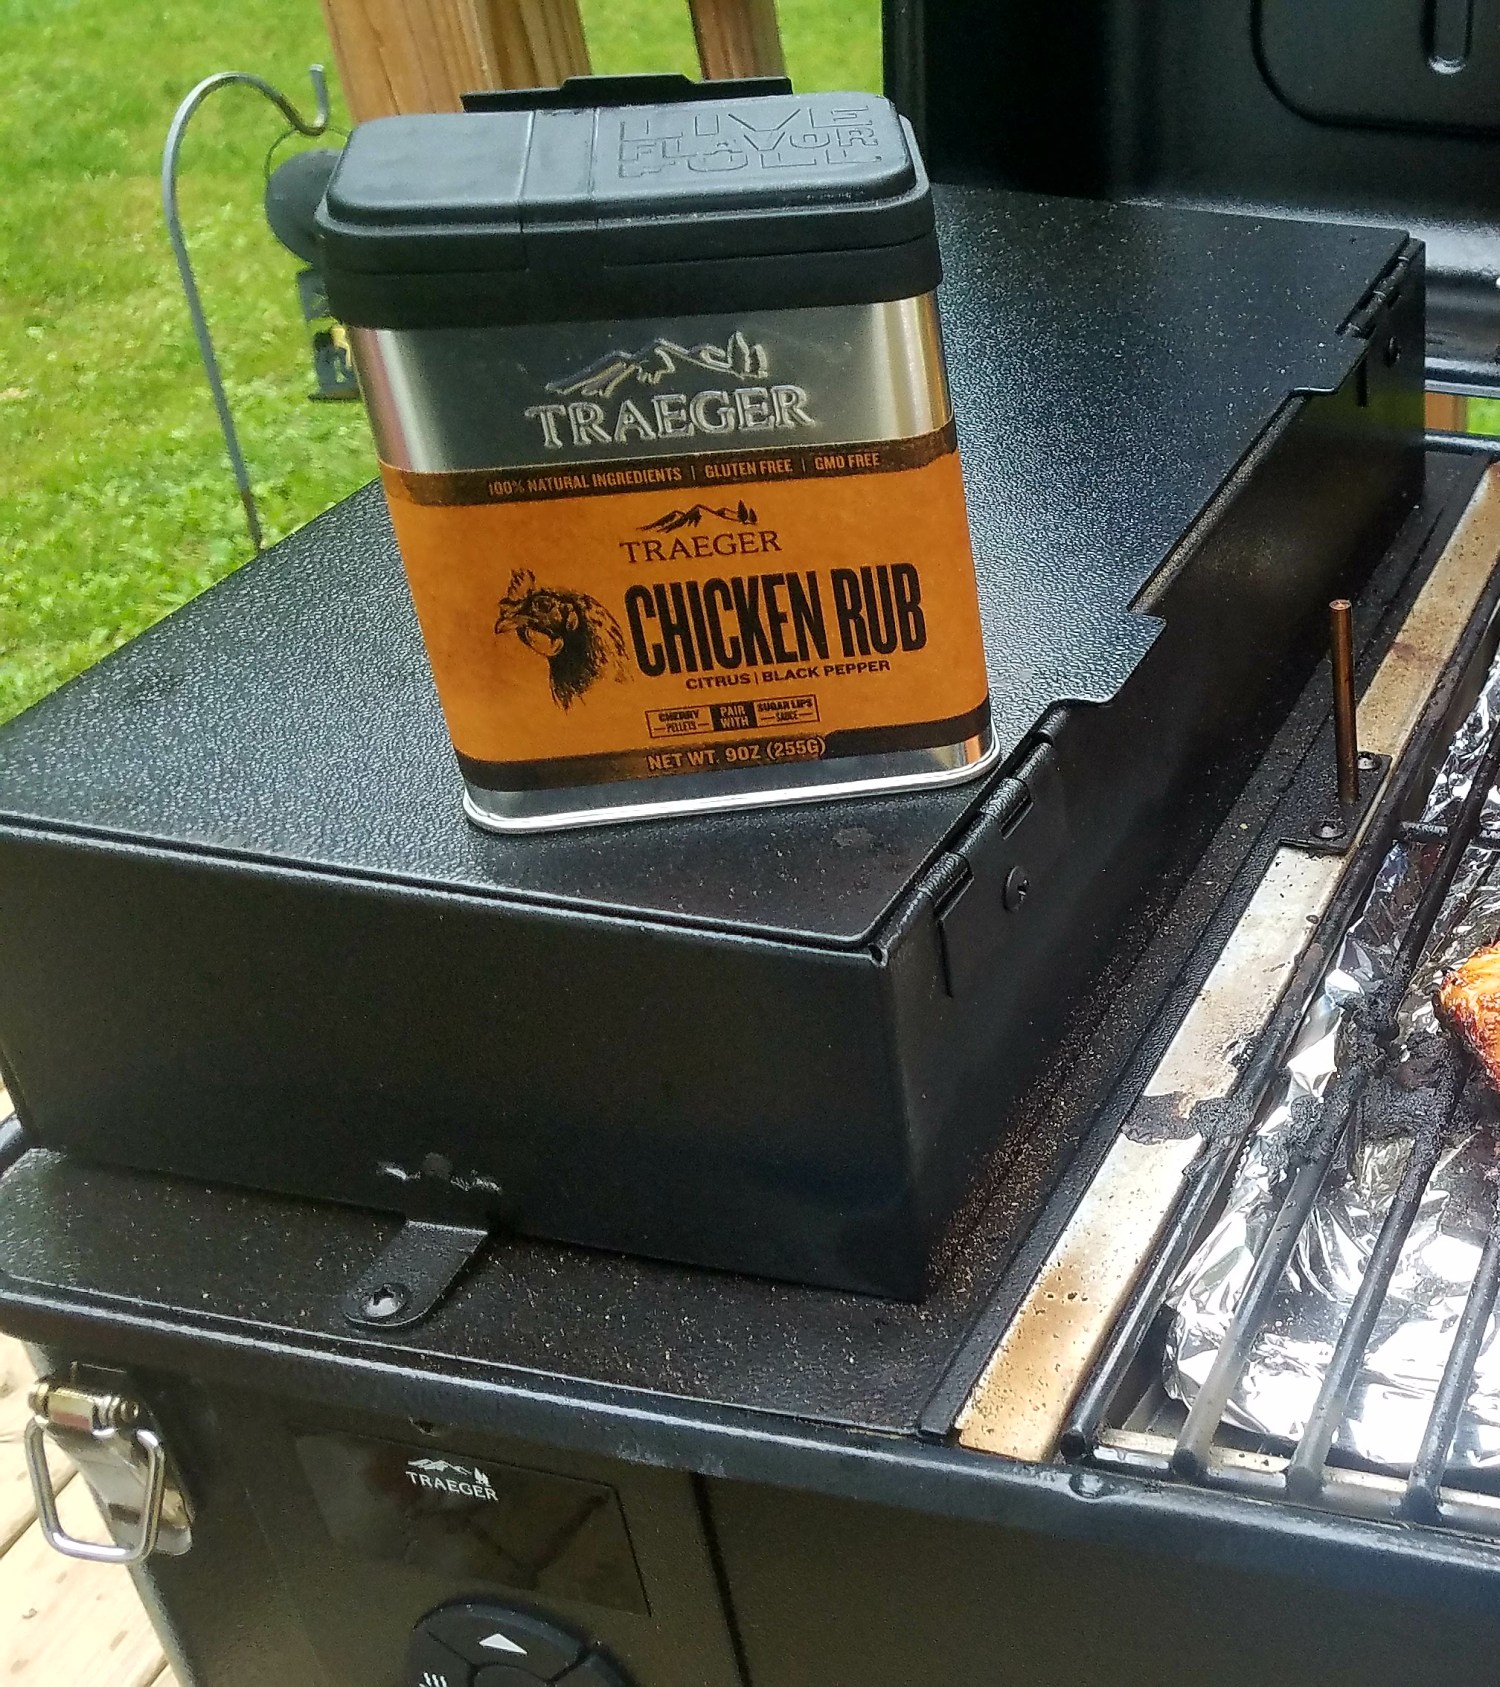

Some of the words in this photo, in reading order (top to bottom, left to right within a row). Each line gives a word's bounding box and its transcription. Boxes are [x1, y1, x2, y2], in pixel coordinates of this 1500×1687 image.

[619, 104, 873, 142] LIVE
[618, 126, 879, 162] FLAVOR
[524, 384, 816, 449] TRAEGER
[705, 461, 757, 479] GLUTEN
[759, 458, 793, 475] FREE
[814, 453, 846, 471] GMO
[847, 452, 881, 468] FREE
[488, 479, 525, 496] 100%
[526, 474, 590, 493] NATURAL
[591, 467, 682, 487] INGREDIENTS
[619, 530, 783, 564] TRAEGER
[624, 570, 830, 677] CHICKEN
[831, 562, 928, 658] RUB
[685, 672, 751, 690] CITRUS
[762, 666, 819, 683] BLACK
[824, 660, 891, 677] PEPPER
[719, 703, 746, 717] PAIR
[757, 701, 791, 713] SUGAR
[791, 698, 813, 709] LIPS
[719, 715, 750, 729] WITH
[648, 752, 684, 771] NET
[687, 750, 721, 767] WT.
[766, 737, 827, 761] (255G)
[404, 1470, 499, 1501] TRAEGER
